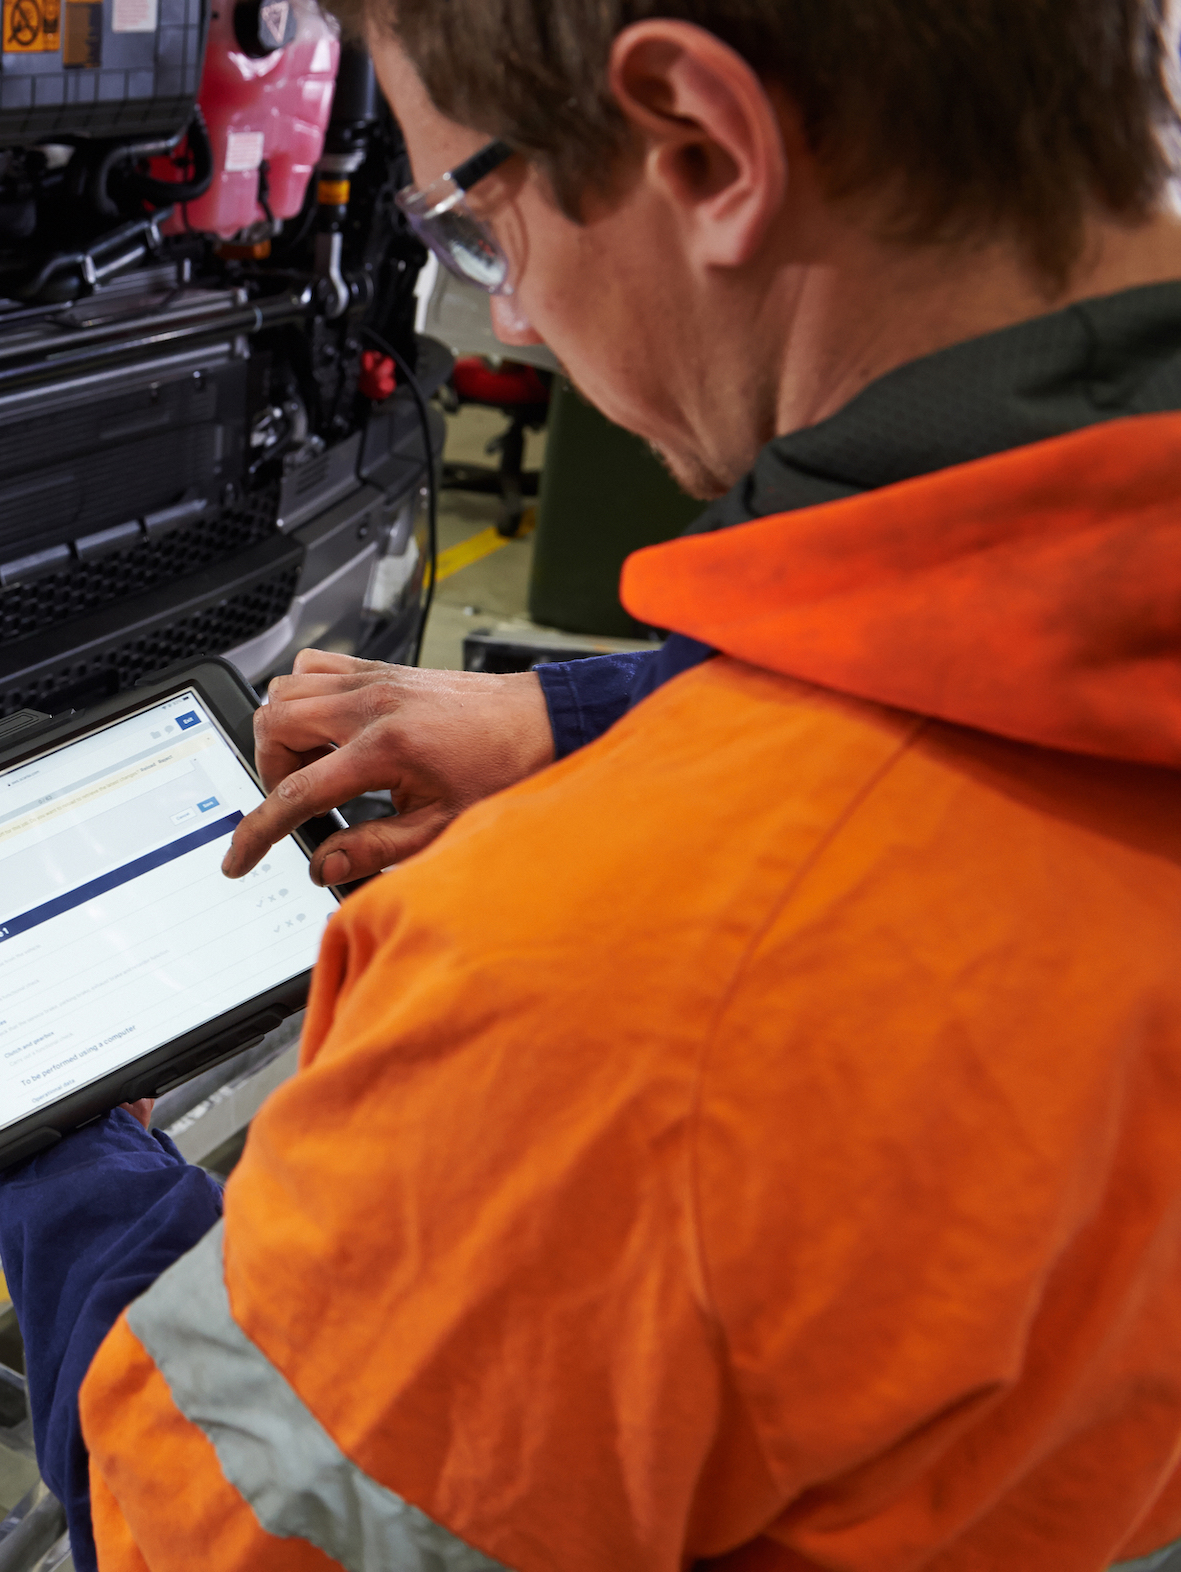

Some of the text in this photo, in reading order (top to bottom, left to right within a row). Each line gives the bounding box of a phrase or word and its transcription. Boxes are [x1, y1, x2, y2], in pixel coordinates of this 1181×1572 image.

[2, 927, 9, 935] 1
[4, 1030, 55, 1059] Clutch and gearbox
[21, 1077, 32, 1087] To
[31, 1072, 42, 1082] be
[41, 1054, 79, 1078] performed
[78, 1044, 99, 1059] using
[103, 1024, 137, 1046] computer
[31, 1078, 75, 1104] Operational data
